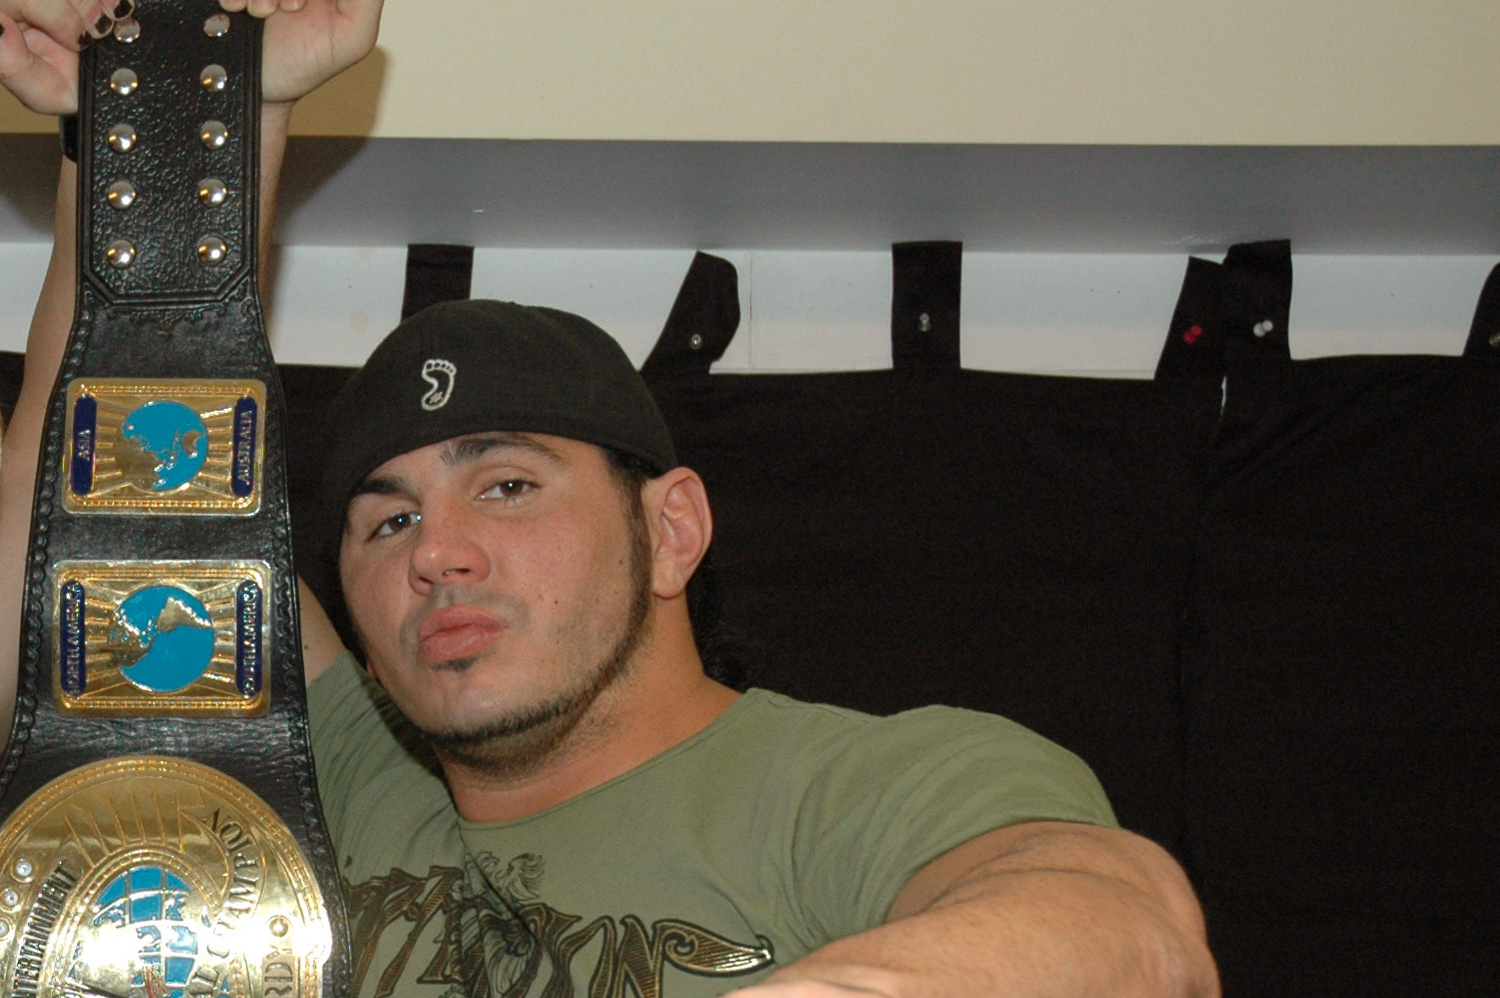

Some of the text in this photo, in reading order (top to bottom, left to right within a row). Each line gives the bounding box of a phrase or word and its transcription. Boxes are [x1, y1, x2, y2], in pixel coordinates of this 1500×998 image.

[77, 427, 92, 461] ASIA
[236, 409, 254, 487] AUSTRALIA
[65, 582, 82, 696] NORTH AMERICA
[244, 583, 259, 649] AMERICA
